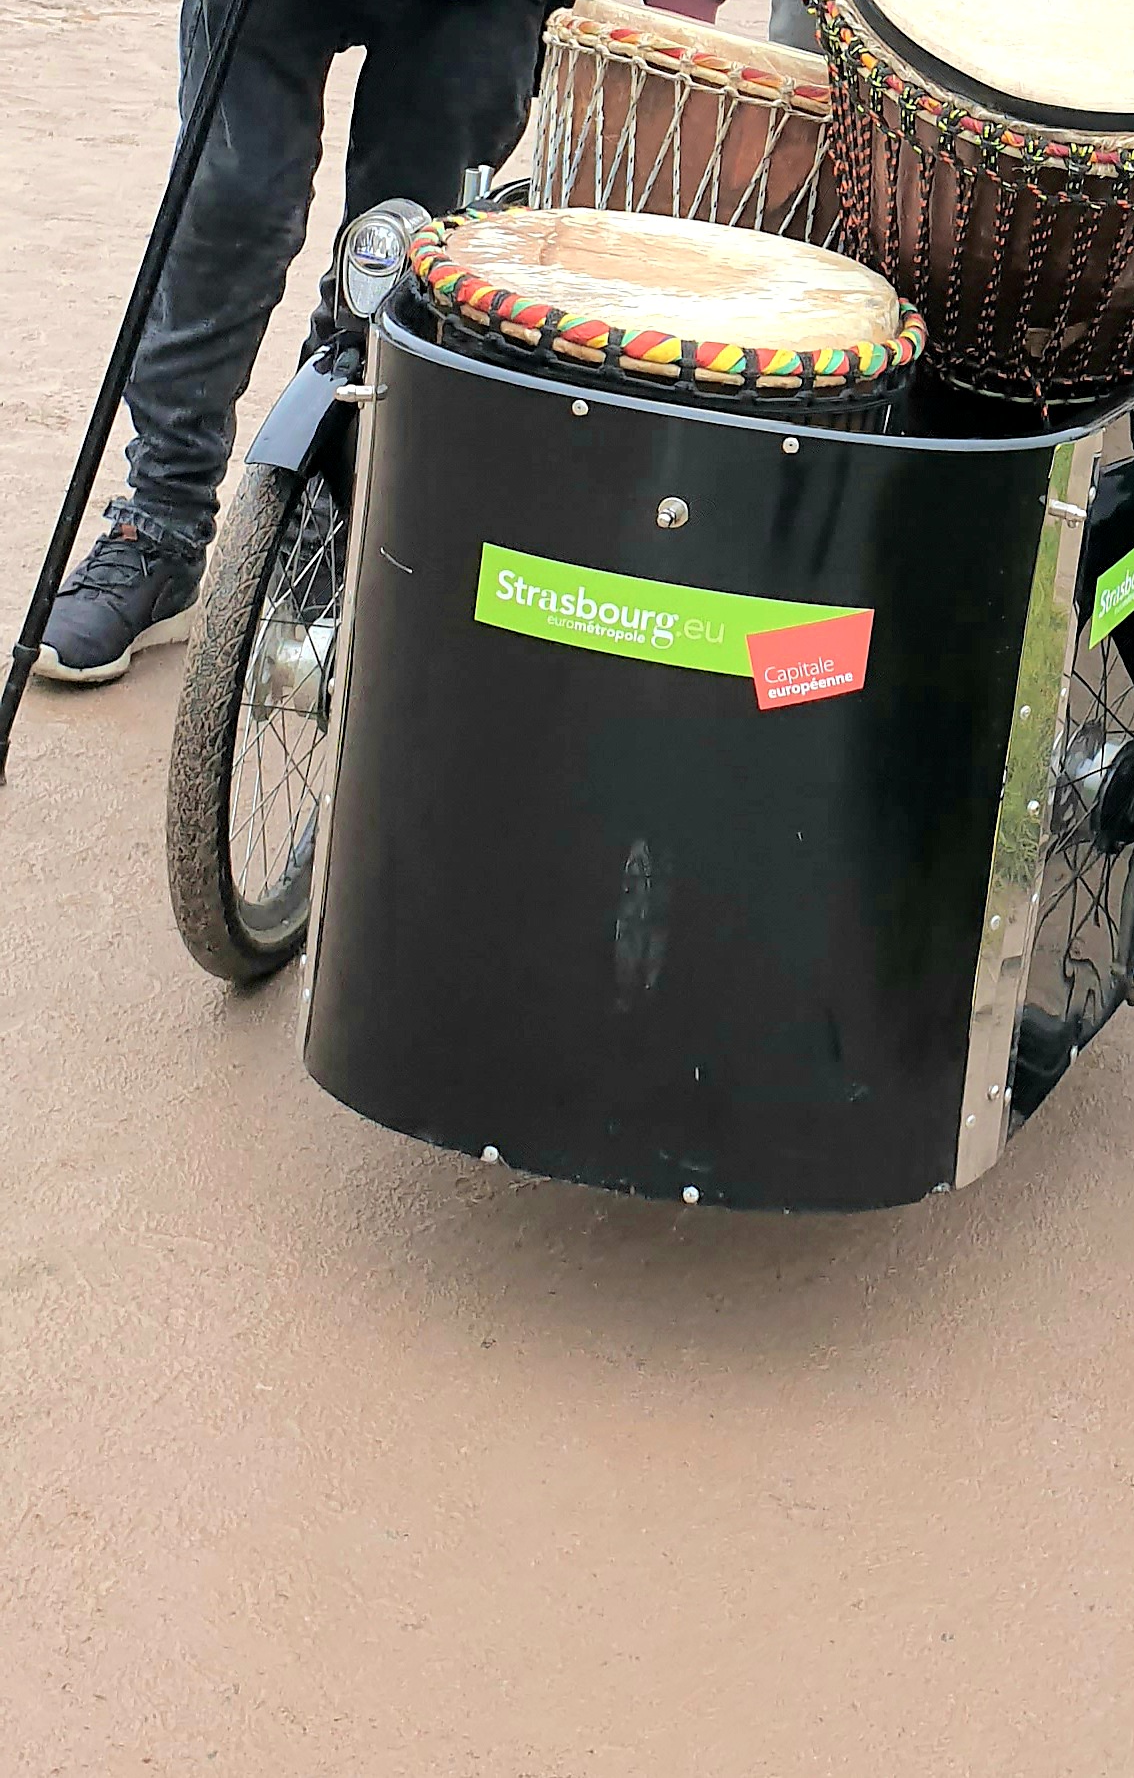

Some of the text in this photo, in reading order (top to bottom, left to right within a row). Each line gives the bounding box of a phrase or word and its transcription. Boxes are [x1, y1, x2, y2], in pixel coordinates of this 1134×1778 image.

[495, 568, 725, 650] Strasbourg.eu
[546, 614, 646, 644] eurométropole
[764, 656, 834, 685] Capitale
[767, 670, 854, 699] européenne
